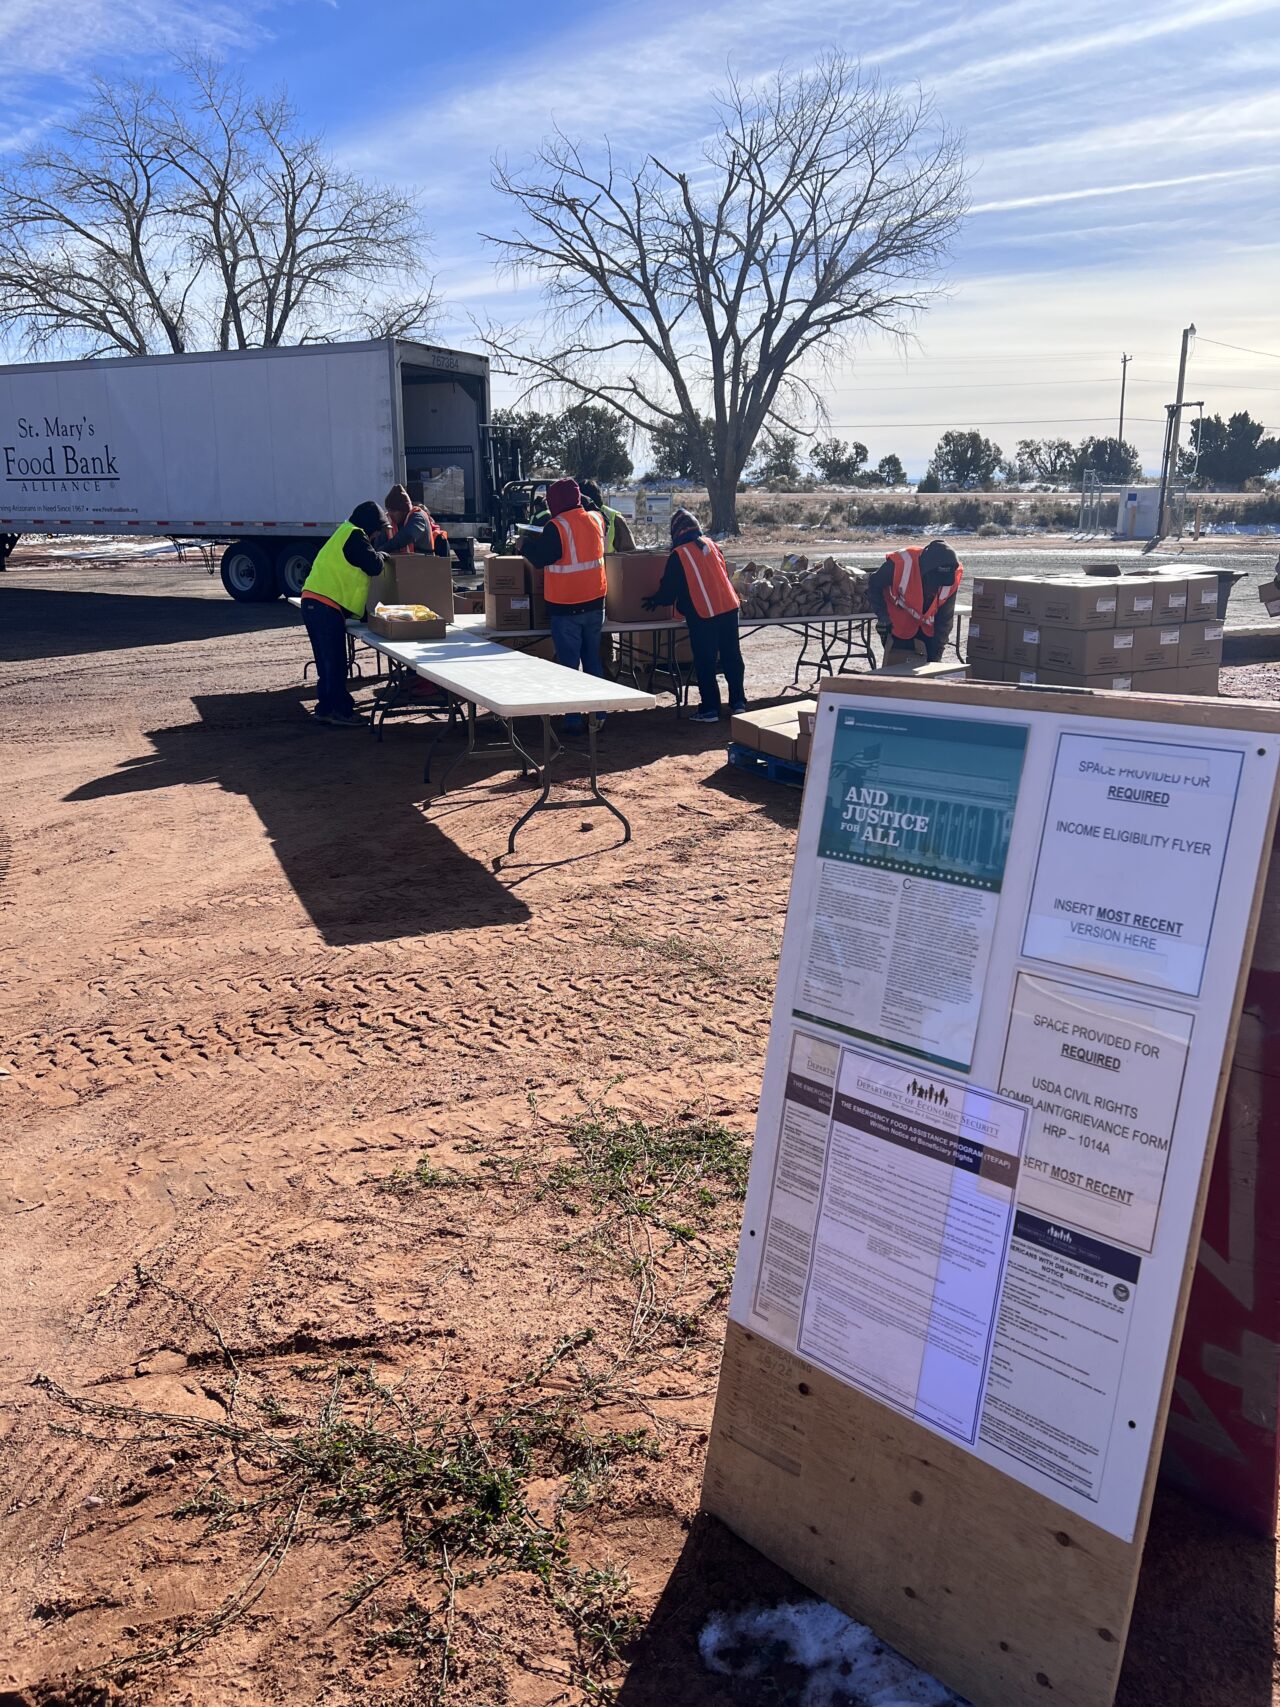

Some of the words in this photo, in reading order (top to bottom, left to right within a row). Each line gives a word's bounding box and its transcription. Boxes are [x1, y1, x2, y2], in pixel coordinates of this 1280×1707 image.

[18, 418, 39, 438] St.
[43, 416, 95, 441] Mary's
[3, 446, 56, 475] Food
[62, 444, 119, 475] Bank
[21, 481, 101, 492] ALLIANCE
[43, 504, 56, 512] Need
[57, 504, 71, 512] Since
[72, 504, 84, 512] 1967
[1079, 760, 1116, 776] SPACE
[845, 786, 888, 807] AND
[1108, 785, 1170, 805] REQUIRED
[842, 804, 930, 832] JUSTICE
[840, 822, 860, 833] FOR
[861, 826, 900, 847] ALL
[1056, 820, 1101, 838] INCOME
[1103, 828, 1170, 848] ELIGIBILITY
[1171, 838, 1211, 855] FLYER
[1054, 898, 1095, 916] INSERT
[1096, 906, 1131, 923] MOST
[1133, 914, 1184, 935] RECENT
[1070, 921, 1120, 942] VERSION
[1123, 932, 1157, 950] HERE
[1033, 1014, 1070, 1034] SPACE
[1072, 1024, 1131, 1050] PROVIDED
[1134, 1042, 1160, 1059] FOR
[1061, 1043, 1121, 1070] REQUIRED
[793, 1080, 802, 1088] THE
[804, 1083, 833, 1100] EMERGENC
[1032, 1076, 1061, 1096] USDA
[1064, 1087, 1091, 1106] CIVIL
[1094, 1096, 1138, 1119] RIGHTS
[1000, 1088, 1130, 1139] COMPLAINT/GRIEVANCE
[1132, 1130, 1168, 1152] FORM
[841, 1100, 852, 1110] THE
[852, 1104, 890, 1124] EMERGENCY
[890, 1117, 908, 1130] FOOD
[908, 1124, 948, 1146] ASSISTANCE
[949, 1140, 983, 1157] PROGRAM
[984, 1154, 1011, 1170] (TEFAP)
[870, 1120, 890, 1133] Written
[891, 1126, 909, 1140] Notice
[918, 1138, 952, 1156] Beneficiary
[952, 1152, 973, 1163] Rights
[1043, 1123, 1066, 1139] HRP
[1078, 1135, 1110, 1154] 1014A
[1024, 1154, 1050, 1173] SERT
[1050, 1165, 1084, 1185] MOST
[1086, 1178, 1134, 1204] RECENT
[1011, 1245, 1038, 1260] ERICANS
[1038, 1256, 1054, 1266] WITH
[1054, 1262, 1094, 1284] DISABILITIES
[1095, 1280, 1108, 1289] ACT
[1042, 1264, 1064, 1279] NOTICE
